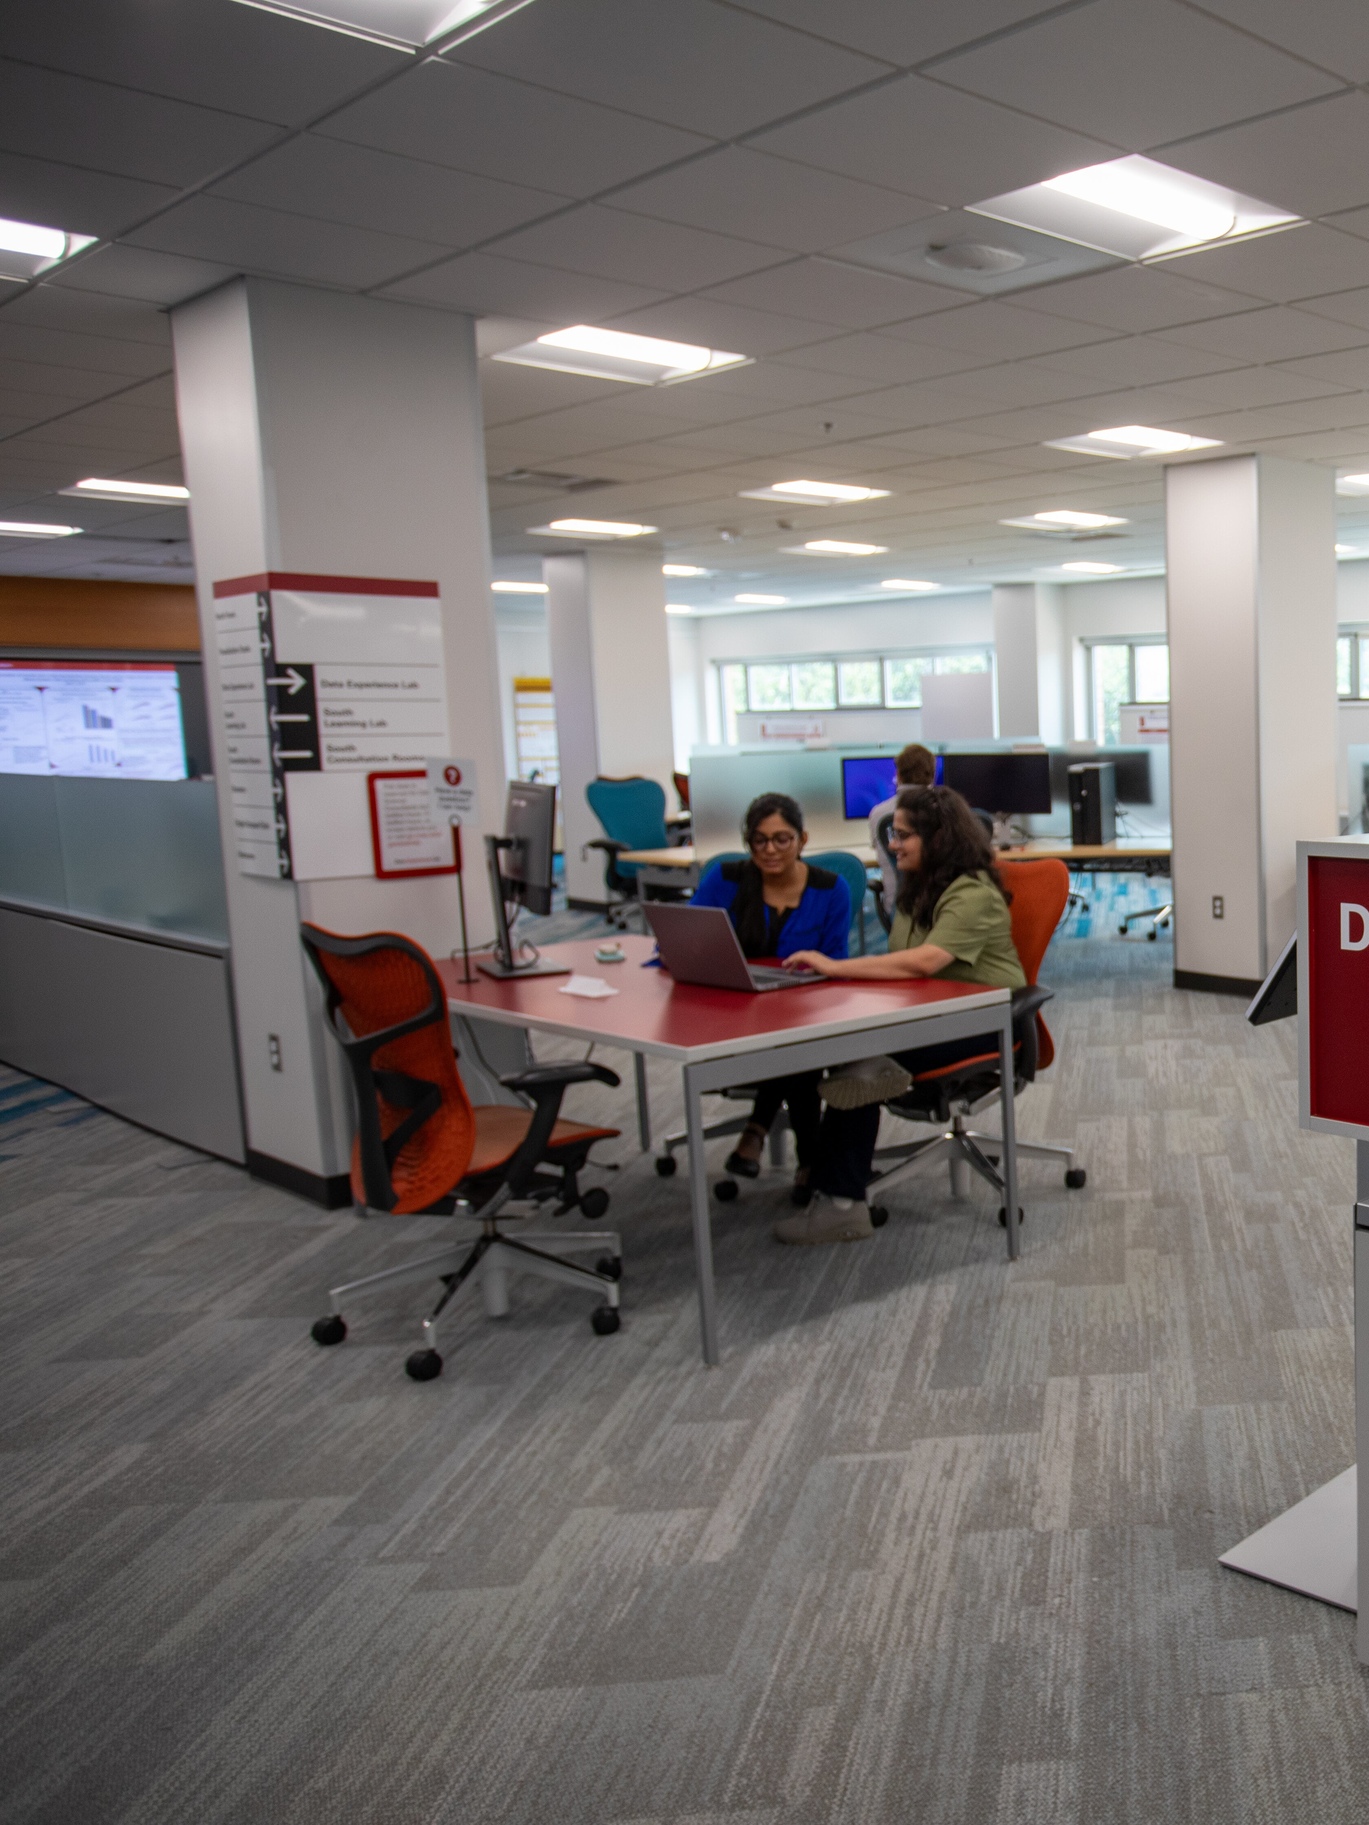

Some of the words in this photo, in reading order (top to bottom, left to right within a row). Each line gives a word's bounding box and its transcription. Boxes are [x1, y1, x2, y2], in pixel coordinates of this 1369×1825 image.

[320, 680, 344, 689] Data
[346, 680, 398, 690] Experience
[401, 681, 419, 689] Lab
[323, 707, 354, 716] South
[324, 719, 366, 730] Learning
[370, 720, 388, 728] Lab
[326, 744, 356, 754] South
[327, 755, 389, 764] Consultation
